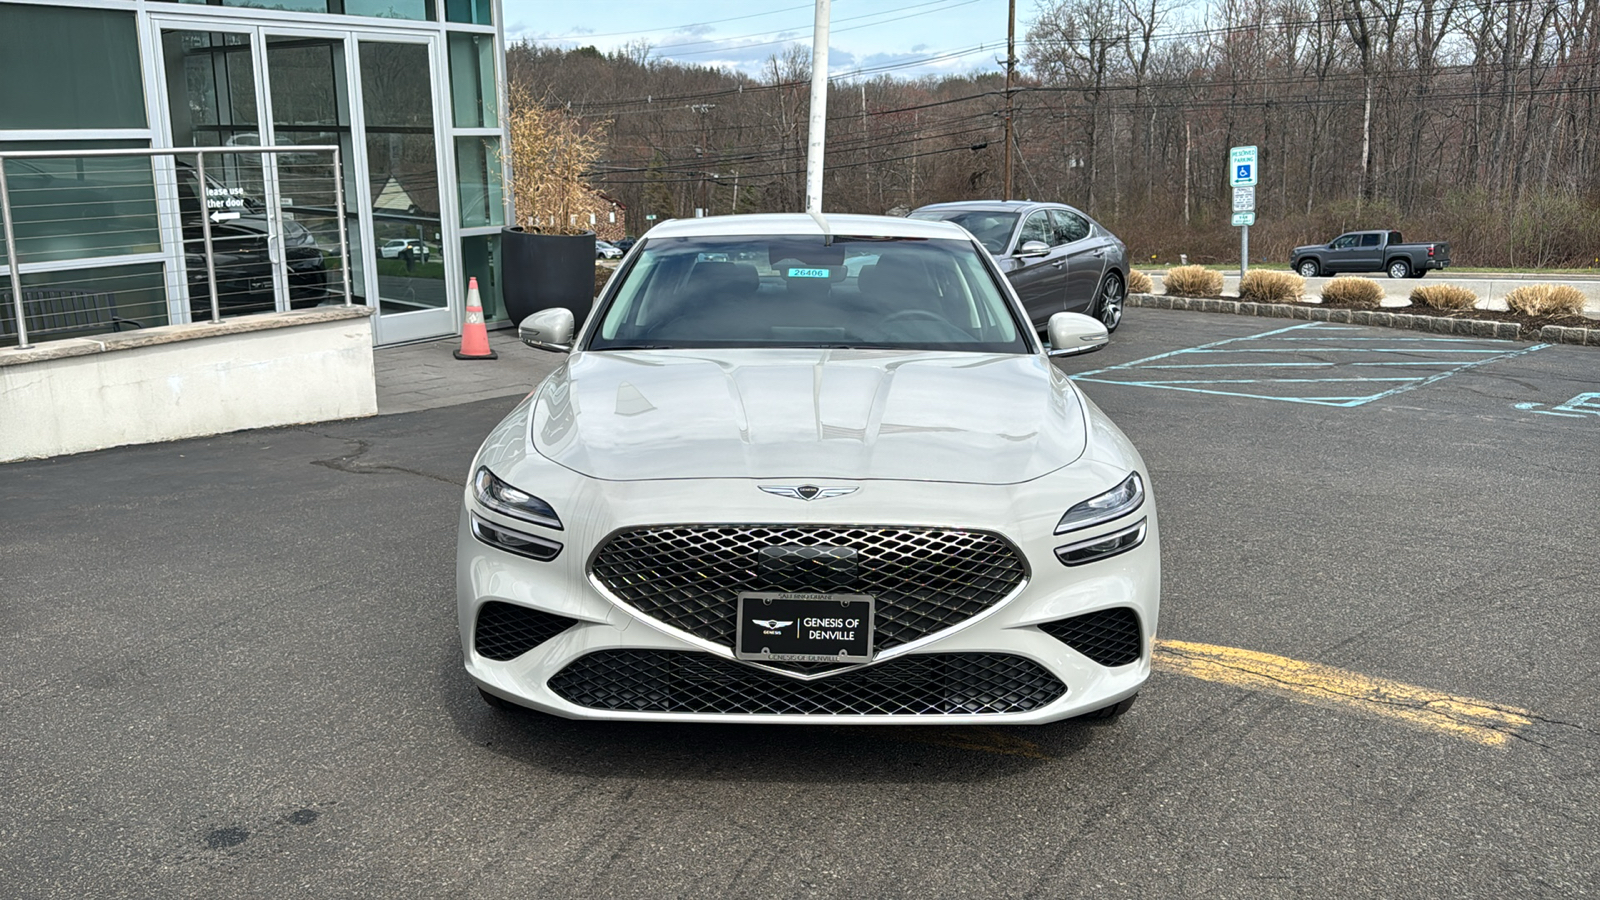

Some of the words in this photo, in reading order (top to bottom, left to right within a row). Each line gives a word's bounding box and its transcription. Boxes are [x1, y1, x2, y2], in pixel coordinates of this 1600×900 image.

[205, 187, 228, 196] lease
[229, 187, 244, 195] use
[206, 199, 224, 208] ther
[225, 198, 244, 207] door
[794, 269, 824, 277] 26406
[803, 618, 843, 628] GENESIS
[845, 619, 859, 628] OF
[809, 630, 855, 640] DENVILLE
